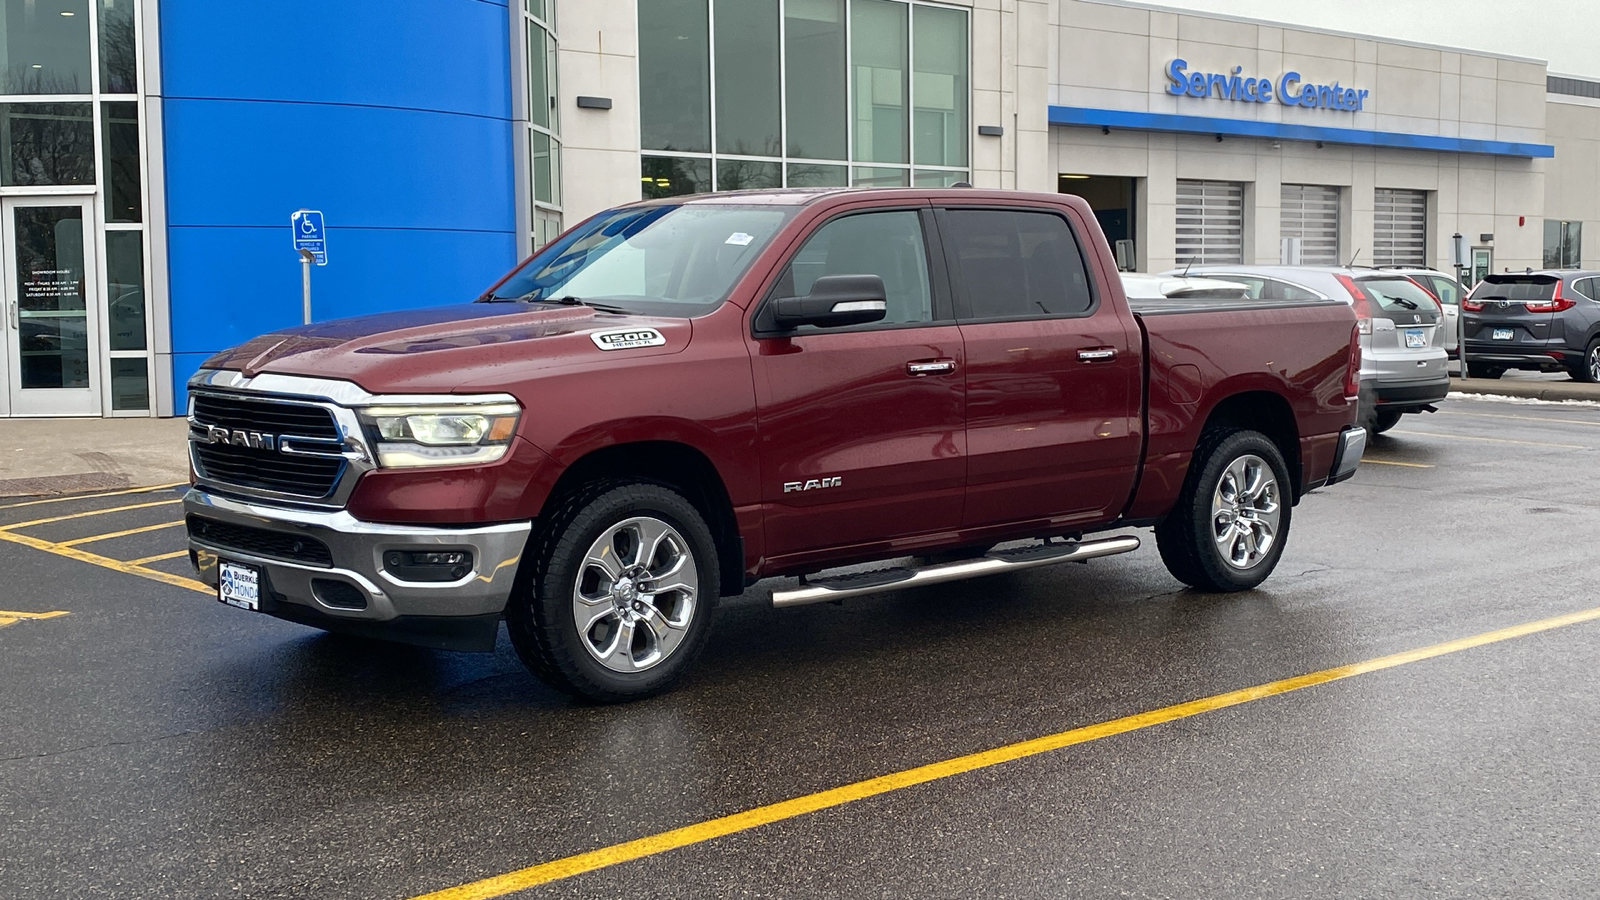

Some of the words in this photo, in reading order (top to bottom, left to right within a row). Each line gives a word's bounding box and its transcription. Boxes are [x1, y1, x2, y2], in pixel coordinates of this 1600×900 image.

[1165, 58, 1272, 103] Service
[1276, 71, 1369, 111] Center
[600, 331, 657, 343] 1500
[208, 426, 274, 450] RAM
[784, 476, 842, 492] RAM
[234, 570, 258, 584] BUERKLE
[234, 581, 258, 599] HONDA
